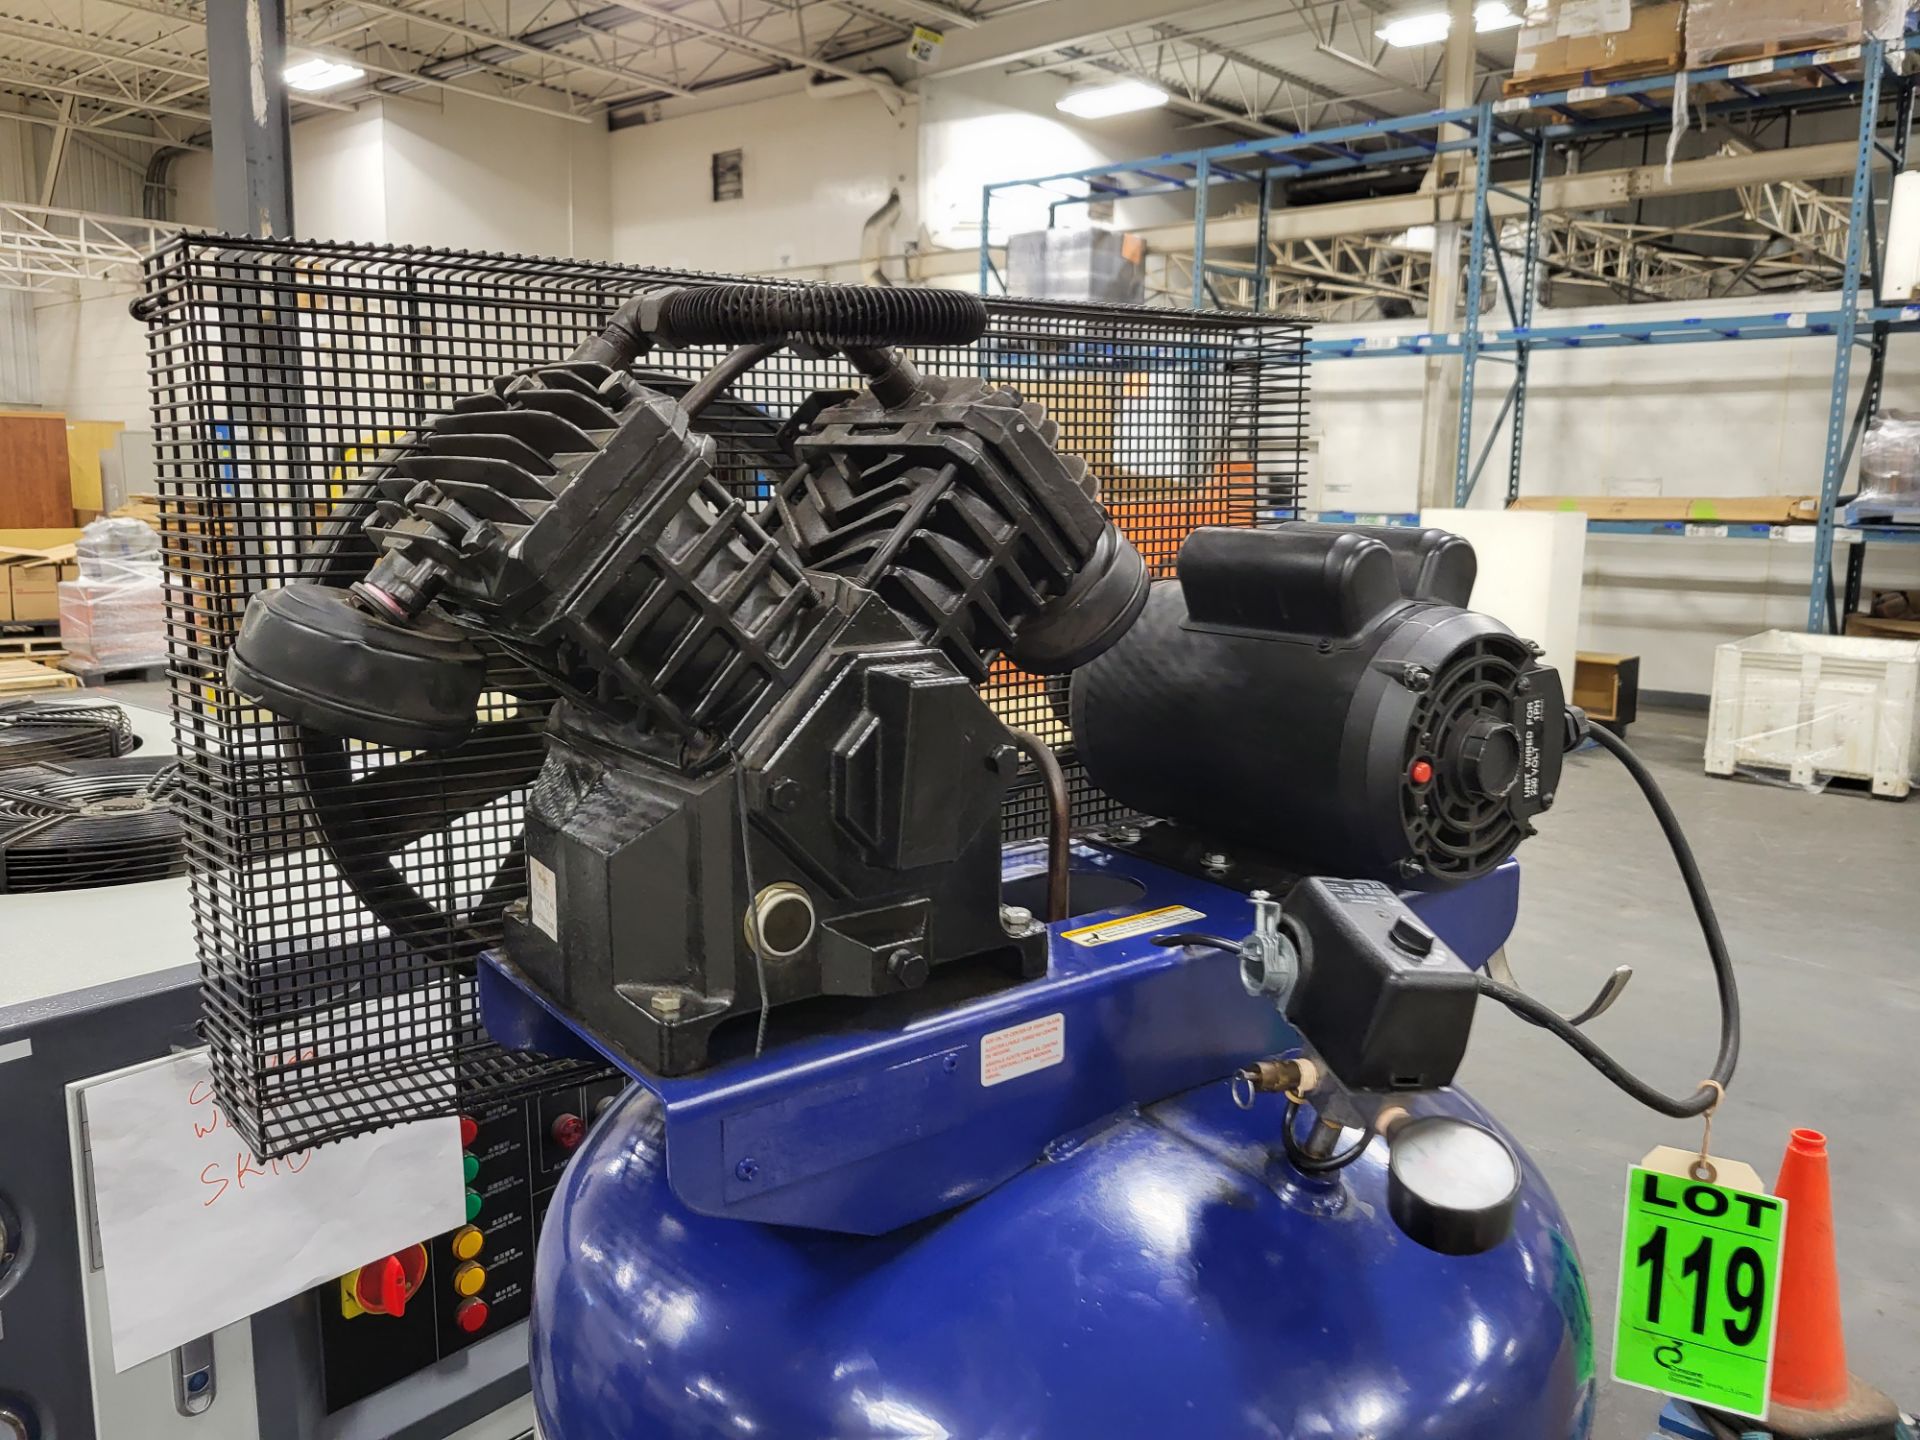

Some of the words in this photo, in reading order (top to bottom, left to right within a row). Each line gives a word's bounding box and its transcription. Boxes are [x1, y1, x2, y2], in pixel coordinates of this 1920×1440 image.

[1526, 702, 1534, 725] FOR
[1525, 731, 1534, 768] WIRED
[1531, 748, 1540, 776] VOLT
[1523, 773, 1532, 798] UNIT
[1642, 1174, 1777, 1228] LOT
[1636, 1225, 1765, 1347] 119
